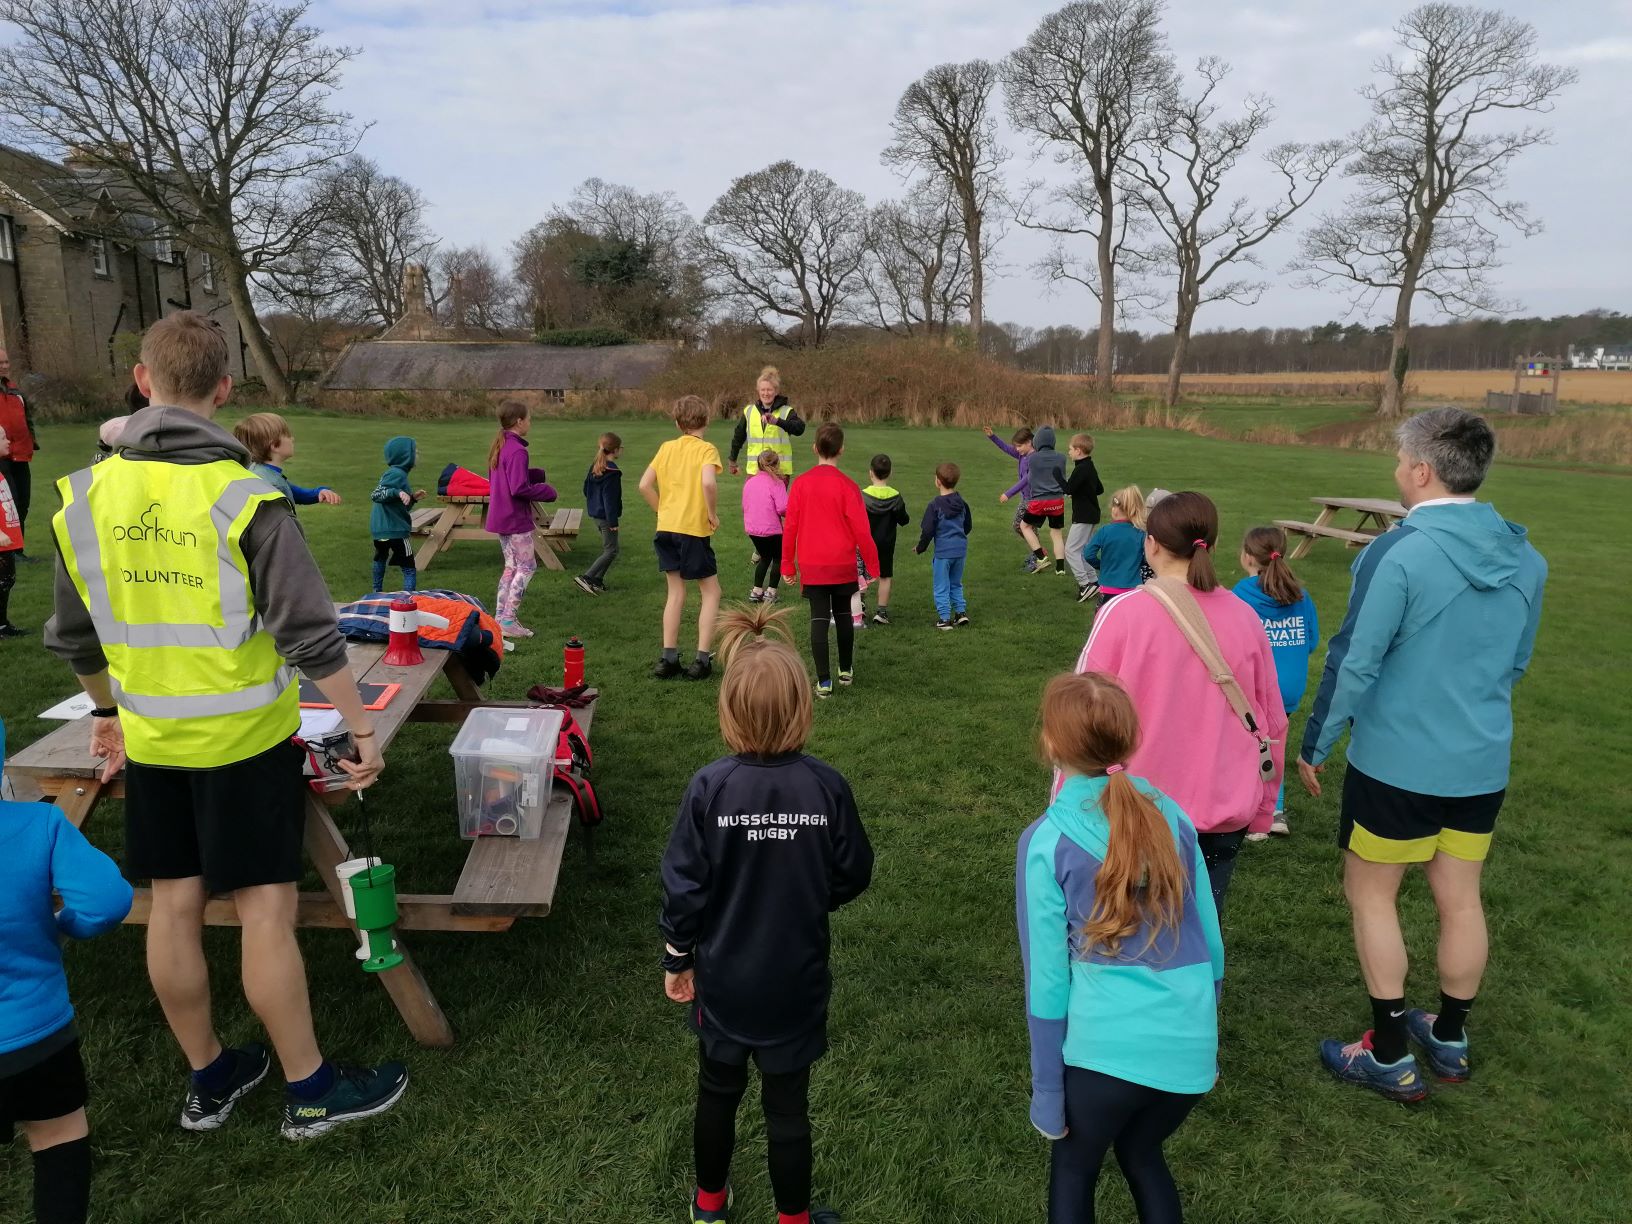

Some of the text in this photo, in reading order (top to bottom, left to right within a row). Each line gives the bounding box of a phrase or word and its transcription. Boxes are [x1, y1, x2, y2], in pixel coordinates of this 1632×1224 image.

[112, 502, 197, 548] parkrun
[1260, 616, 1305, 629] ANKIE
[717, 812, 828, 828] MUSSELBURGH
[747, 827, 798, 841] RUGBY
[295, 1107, 327, 1118] HOKA
